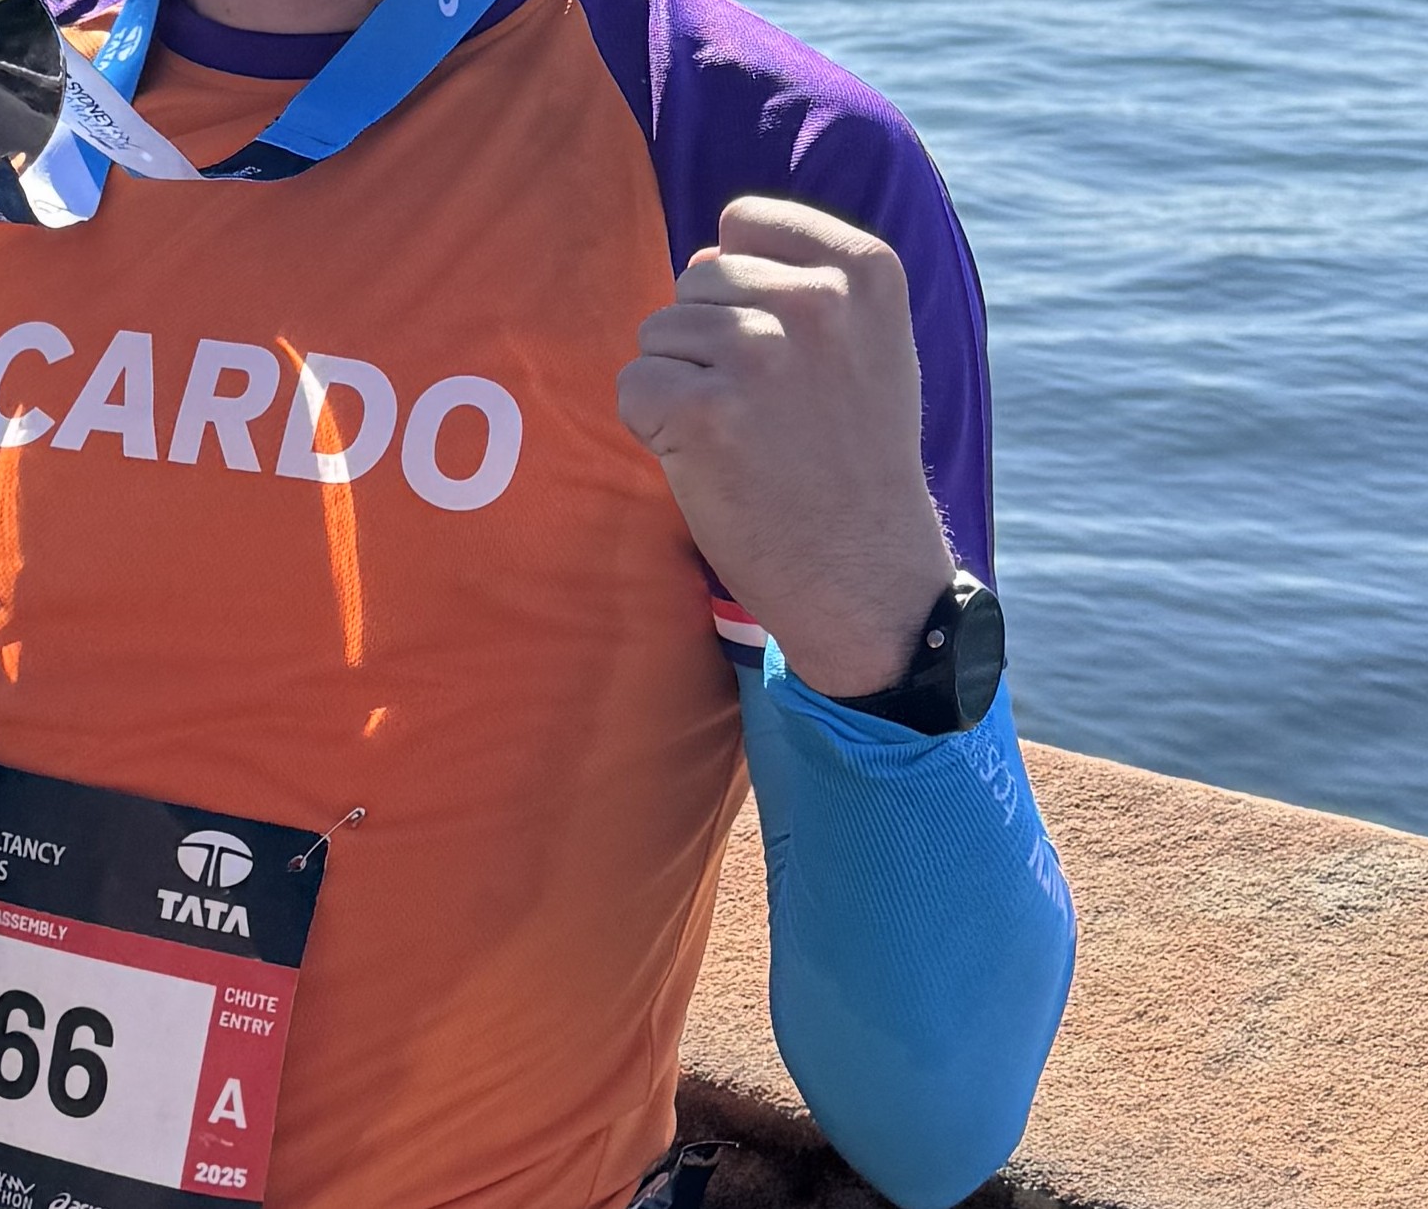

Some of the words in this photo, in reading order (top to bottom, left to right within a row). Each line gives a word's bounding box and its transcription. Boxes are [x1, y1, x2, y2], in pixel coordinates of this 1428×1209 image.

[67, 81, 119, 128] SYDNEY
[157, 888, 251, 938] TATA
[224, 987, 279, 1013] CHUTE
[219, 1011, 274, 1037] ENTRY
[207, 1078, 247, 1129] A
[194, 1162, 248, 1188] 2025
